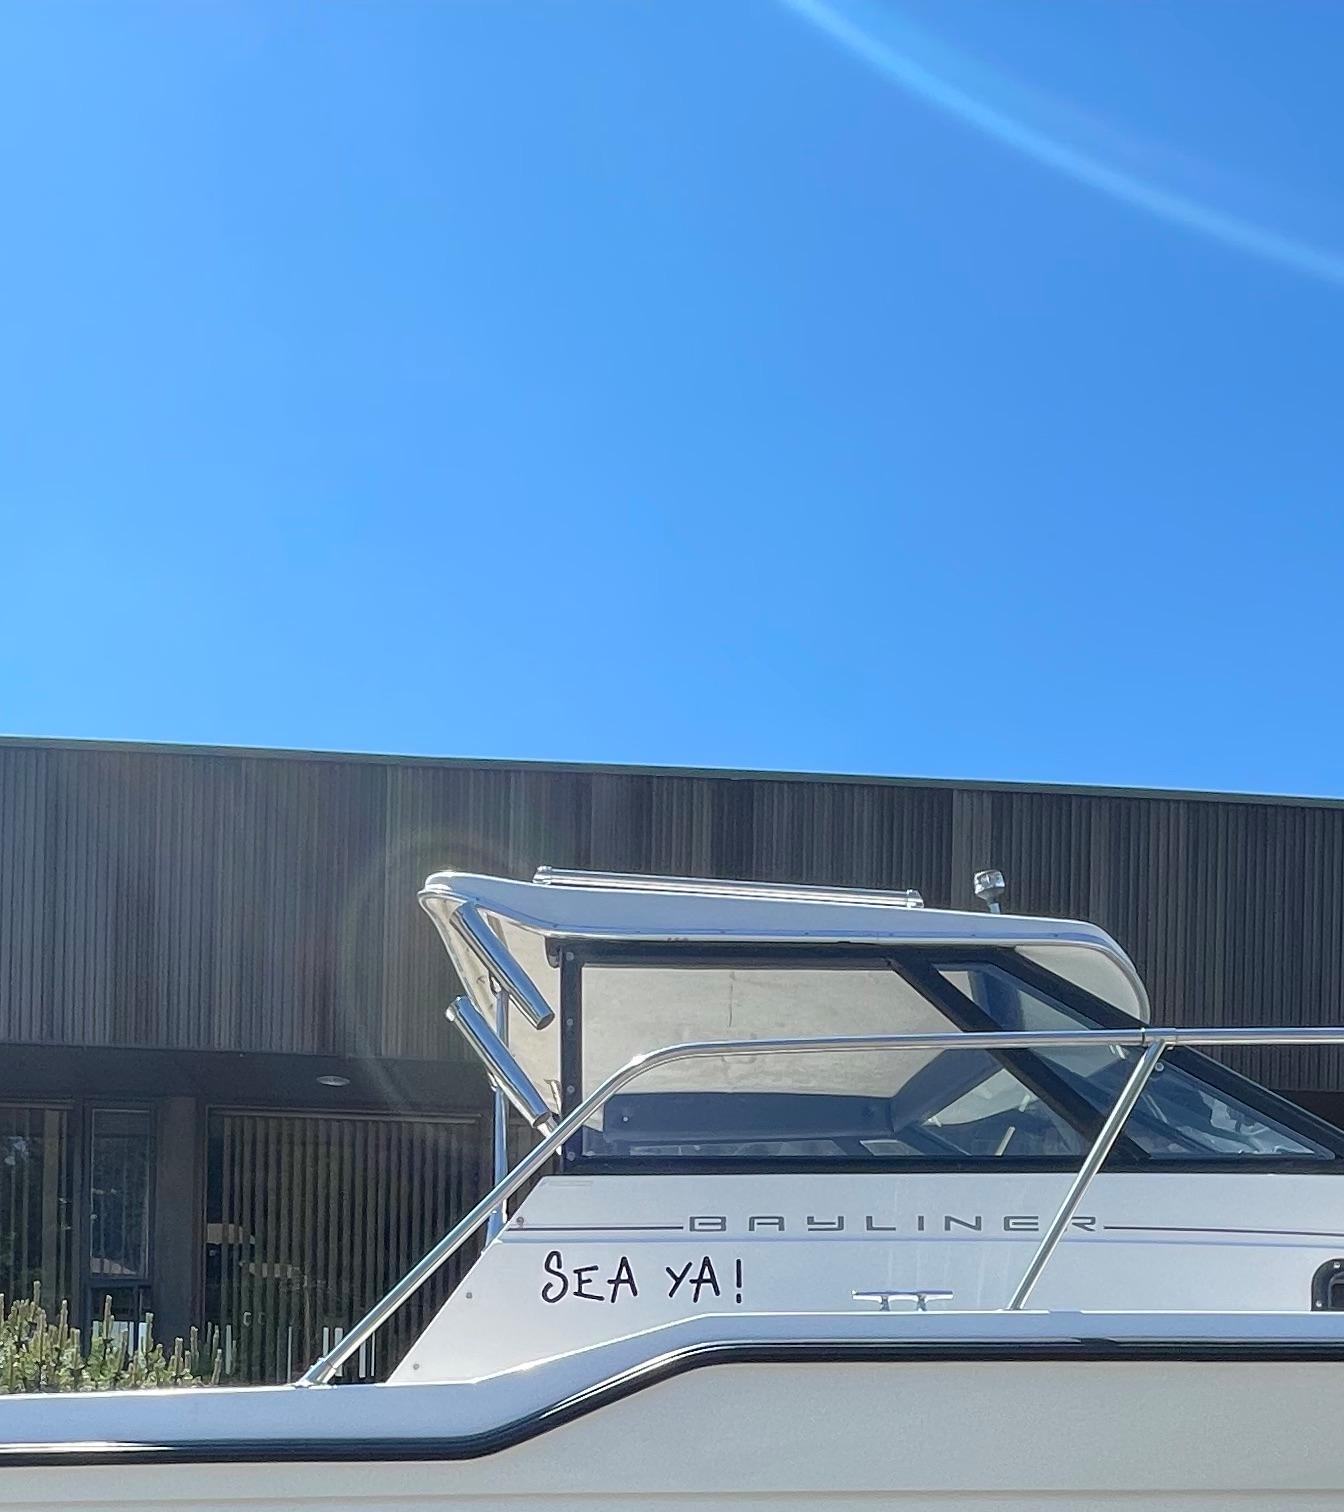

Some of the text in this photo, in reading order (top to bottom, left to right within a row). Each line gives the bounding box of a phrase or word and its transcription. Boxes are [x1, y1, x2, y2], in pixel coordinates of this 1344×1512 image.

[689, 1215, 1097, 1232] BAYLINER
[541, 1250, 743, 1304] SEA YA!
